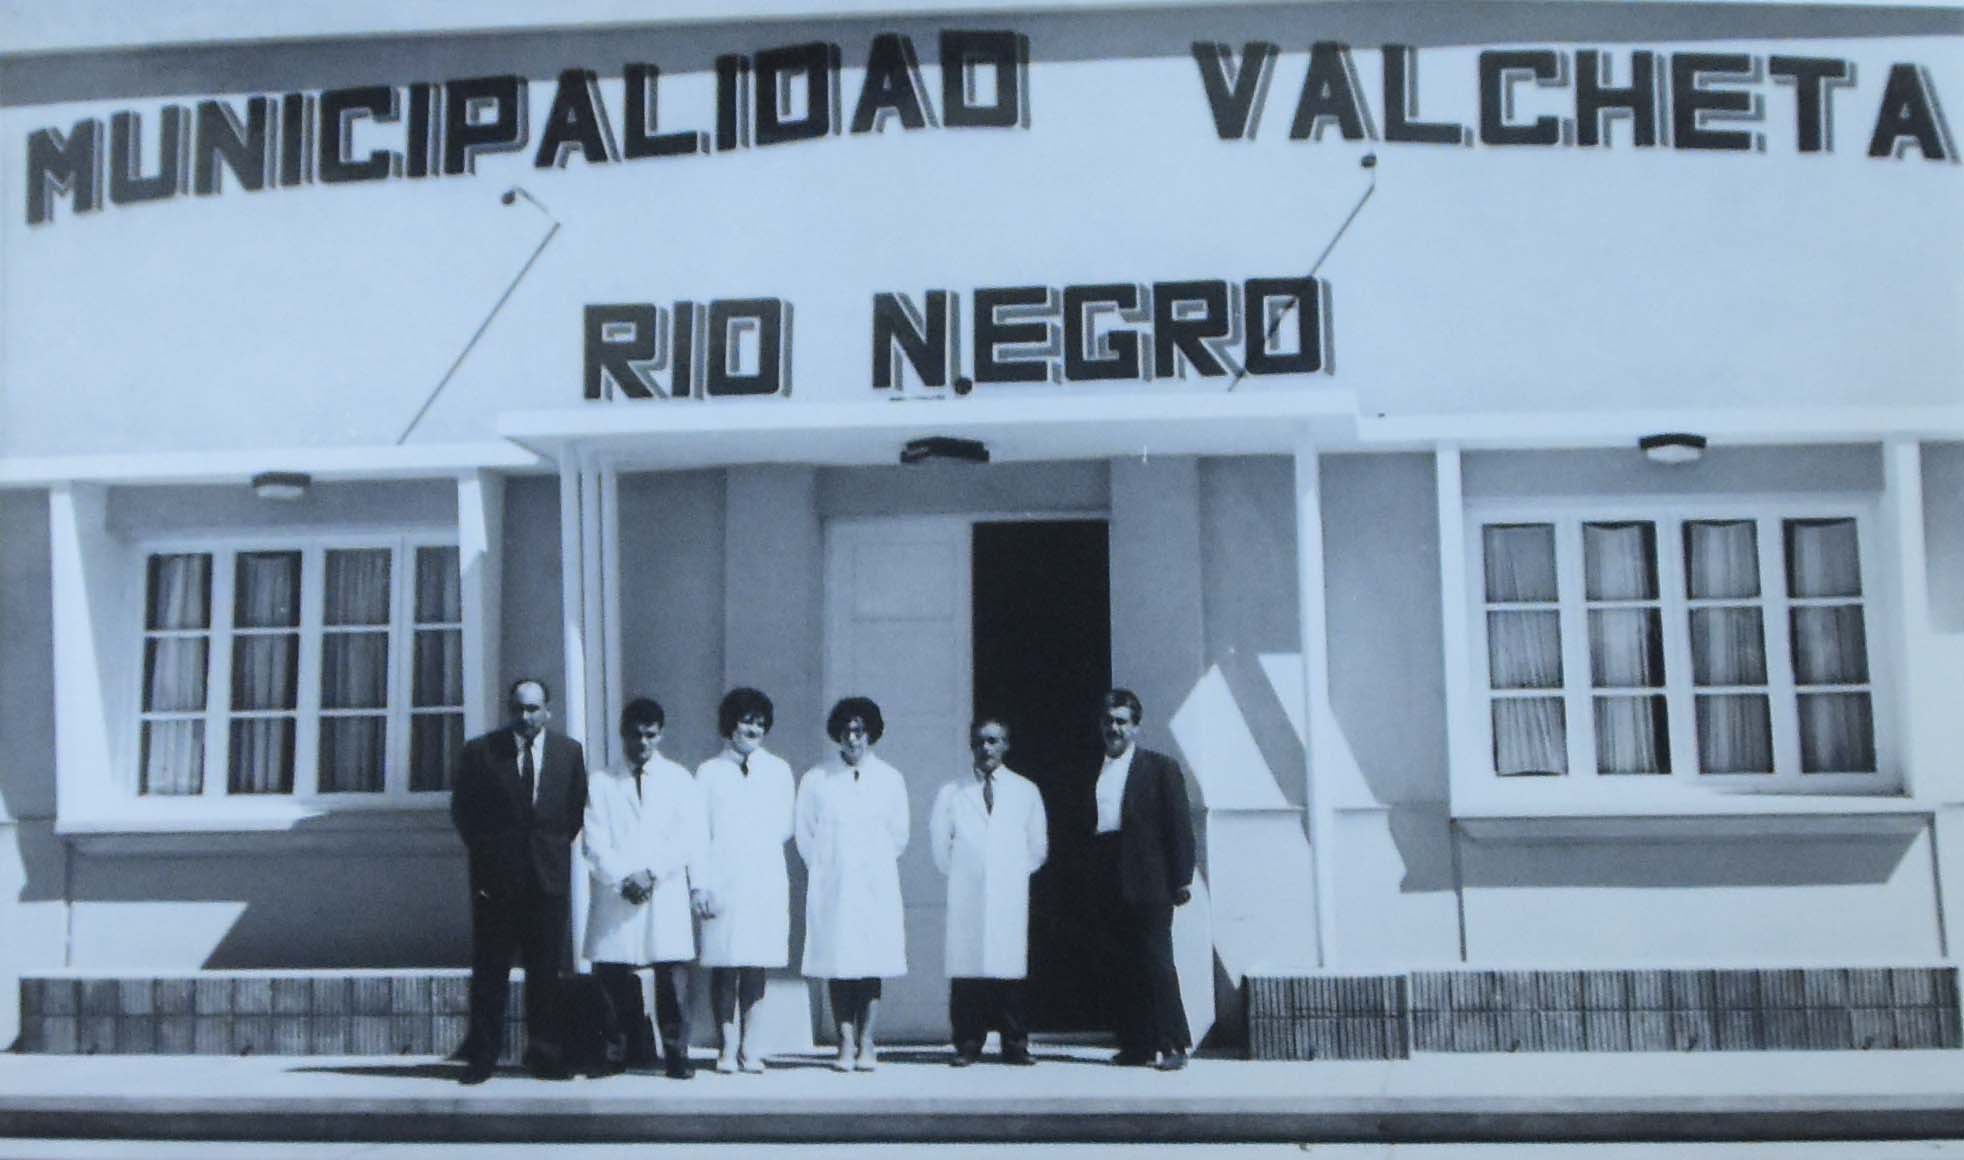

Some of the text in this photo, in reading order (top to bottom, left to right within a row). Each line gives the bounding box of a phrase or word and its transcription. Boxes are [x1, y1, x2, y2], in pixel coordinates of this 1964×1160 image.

[26, 29, 1961, 226] MUNICIPALIDAD VALCHETA
[583, 277, 1335, 401] RIO NEGRO
